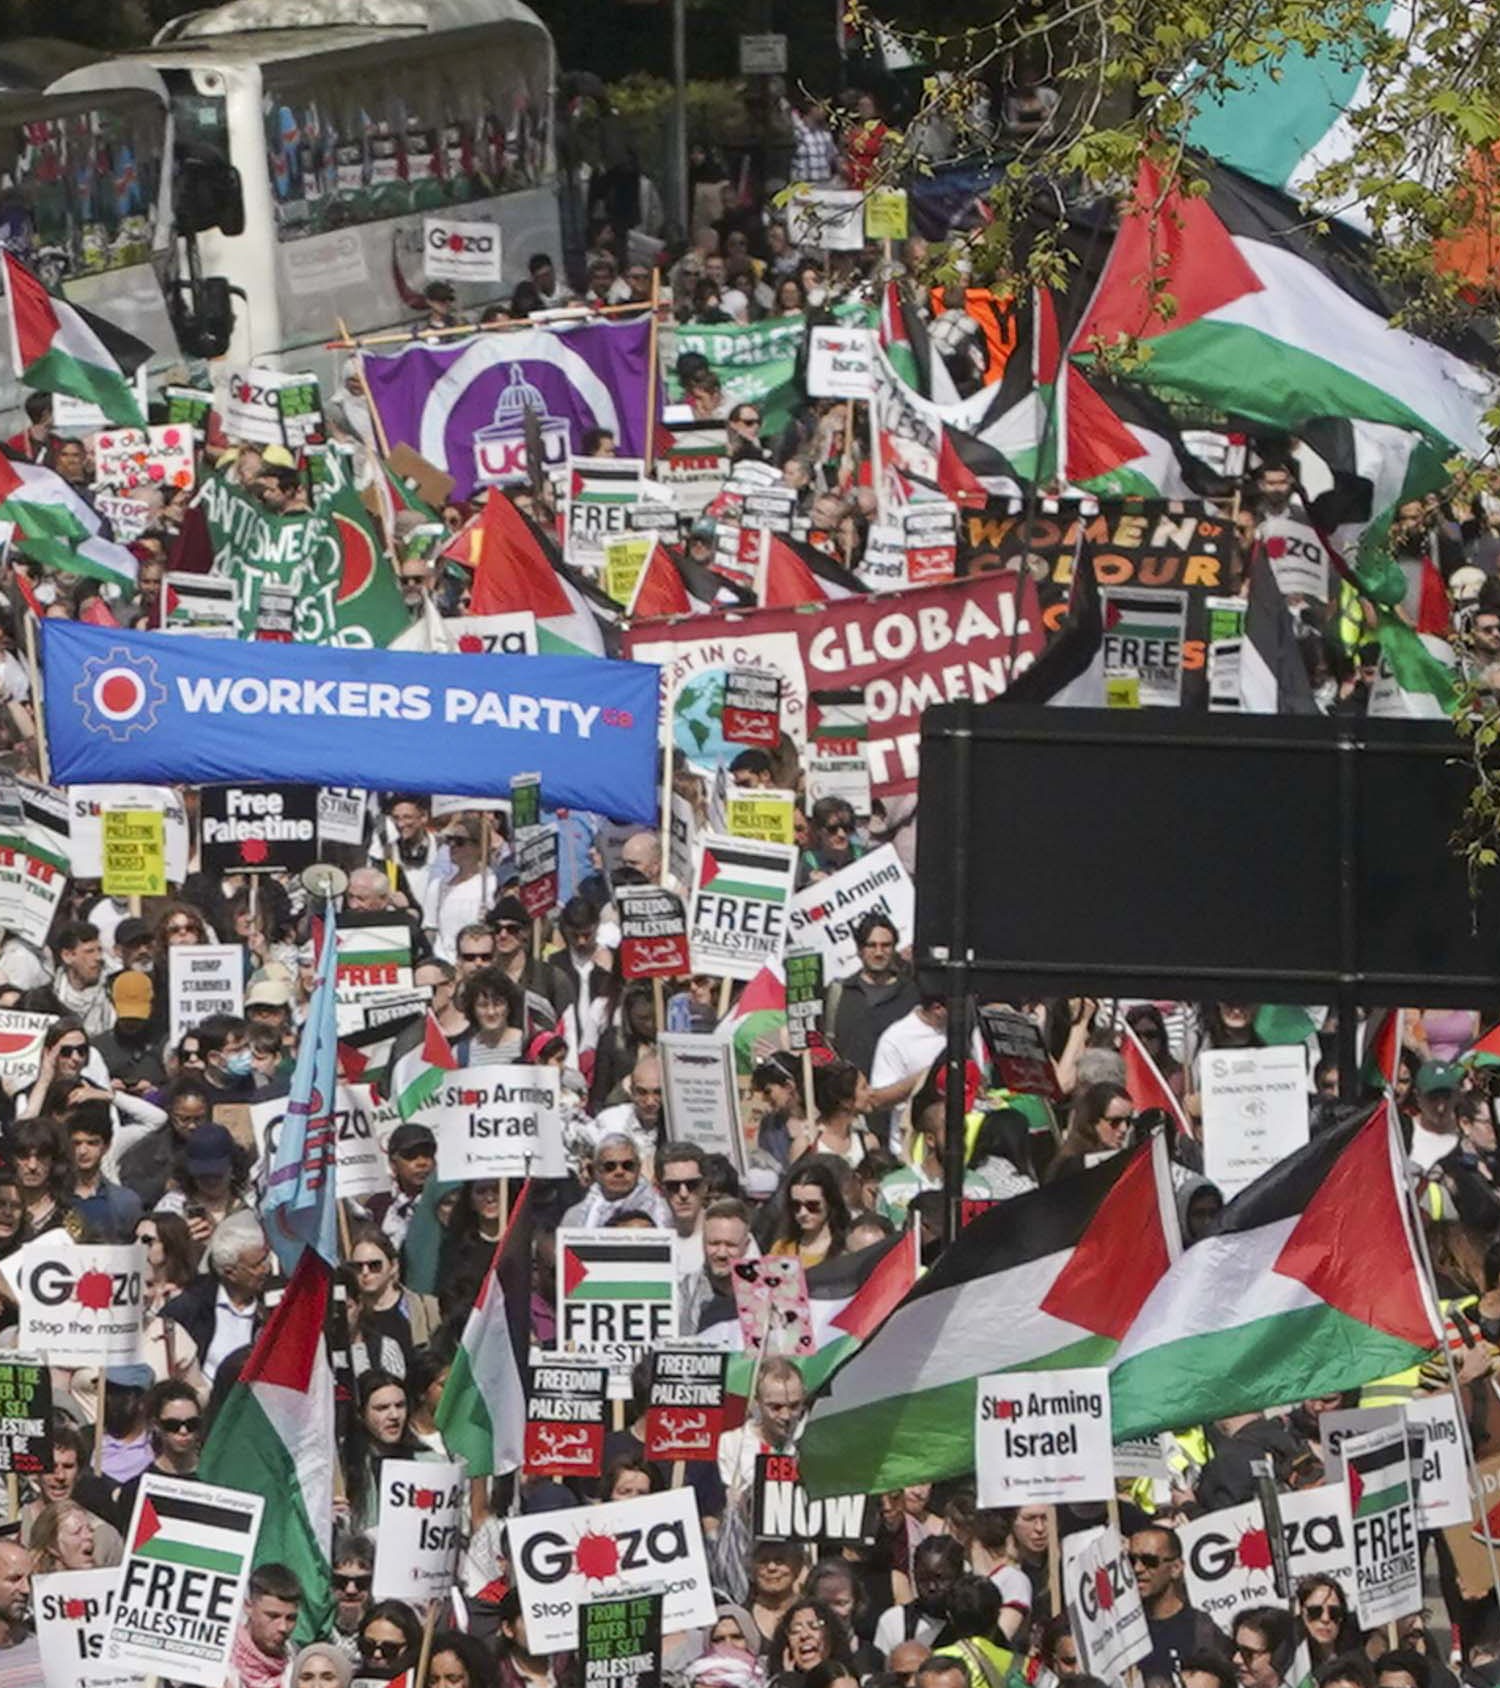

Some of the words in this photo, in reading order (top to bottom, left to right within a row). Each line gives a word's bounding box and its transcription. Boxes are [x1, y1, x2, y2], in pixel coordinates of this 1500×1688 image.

[968, 517, 1198, 549] WOMEN
[809, 593, 1030, 675] GLOBAL
[1103, 634, 1180, 673] FREE
[176, 676, 432, 722] WORKERS
[444, 688, 601, 739] PARTY
[226, 788, 284, 815] Free
[202, 812, 314, 844] Palestine
[835, 861, 902, 909] Arming
[693, 893, 783, 938] FREE
[691, 925, 780, 954] PALESTINE
[446, 1086, 489, 1114] Stp
[492, 1086, 555, 1113] Arming
[468, 1109, 539, 1140] Israel
[564, 1303, 672, 1339] FREE
[534, 1368, 604, 1391] FREEDOM
[657, 1353, 722, 1376] FREEDOM
[528, 1397, 604, 1421] PALESTINE
[651, 1383, 722, 1407] PALESTINE
[979, 1395, 1024, 1422] Stp
[1027, 1392, 1102, 1421] Arming
[1004, 1425, 1079, 1460] Israel
[1352, 1503, 1416, 1558] FREE
[520, 1519, 691, 1585] Gza
[1355, 1554, 1418, 1592] PALESTINE
[120, 1558, 238, 1625] FREE
[531, 1597, 573, 1620] Stop
[114, 1605, 229, 1648] PALESTINE
[586, 1656, 654, 1680] PALESTINE
